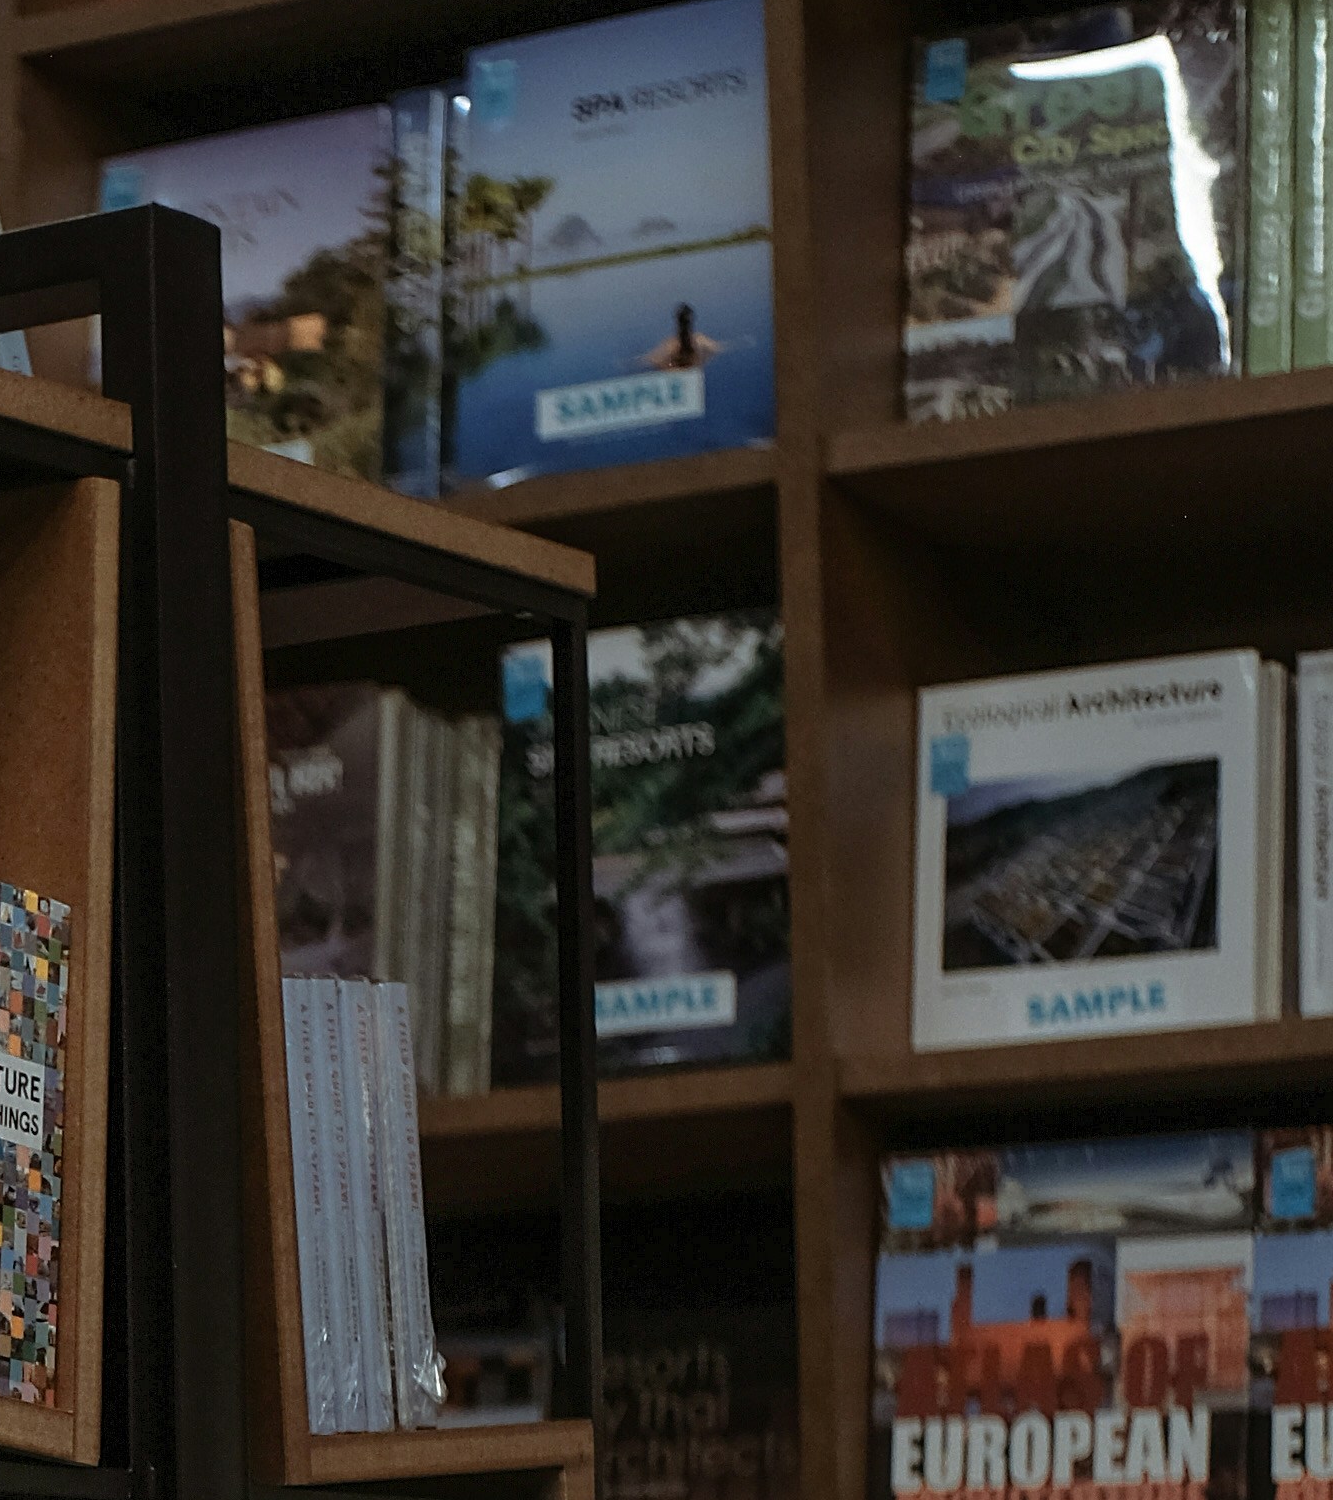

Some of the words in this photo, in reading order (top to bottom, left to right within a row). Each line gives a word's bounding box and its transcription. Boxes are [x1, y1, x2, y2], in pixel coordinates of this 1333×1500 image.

[1066, 679, 1223, 720] Architecture
[1028, 981, 1166, 1027] SAMPLE
[891, 1404, 1211, 1495] EUROPEAN
